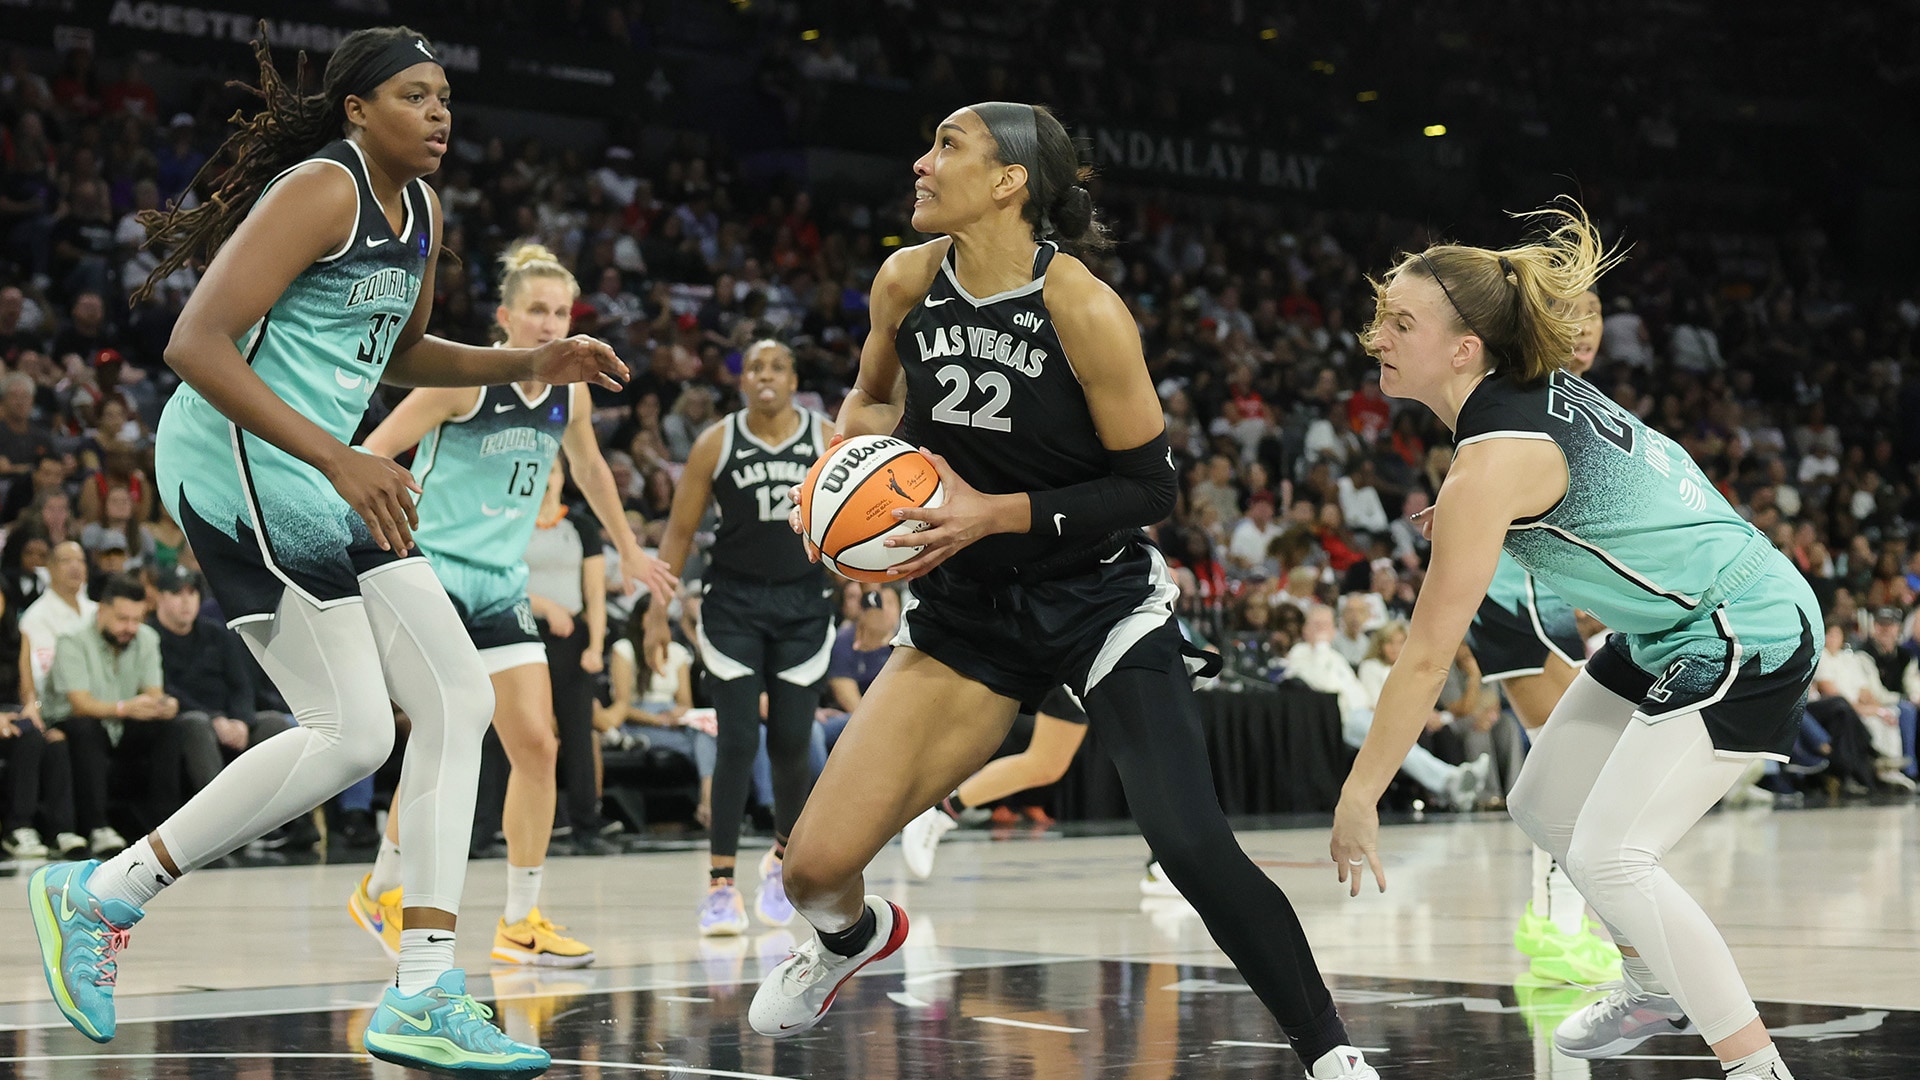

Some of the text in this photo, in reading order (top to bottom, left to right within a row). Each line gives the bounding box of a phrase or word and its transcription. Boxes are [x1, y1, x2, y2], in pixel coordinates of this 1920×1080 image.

[1074, 126, 1325, 191] ANDALAY BAY
[1013, 311, 1045, 333] ally
[915, 325, 1048, 378] LAS VEGAS
[931, 364, 1012, 433] 22
[507, 460, 540, 497] 13
[731, 460, 811, 489] LAS VEGA
[821, 438, 905, 494] Wilson
[755, 484, 794, 522] 12
[865, 498, 889, 516] OFFICIAL
[866, 507, 881, 521] GAME
[880, 499, 893, 512] BALL
